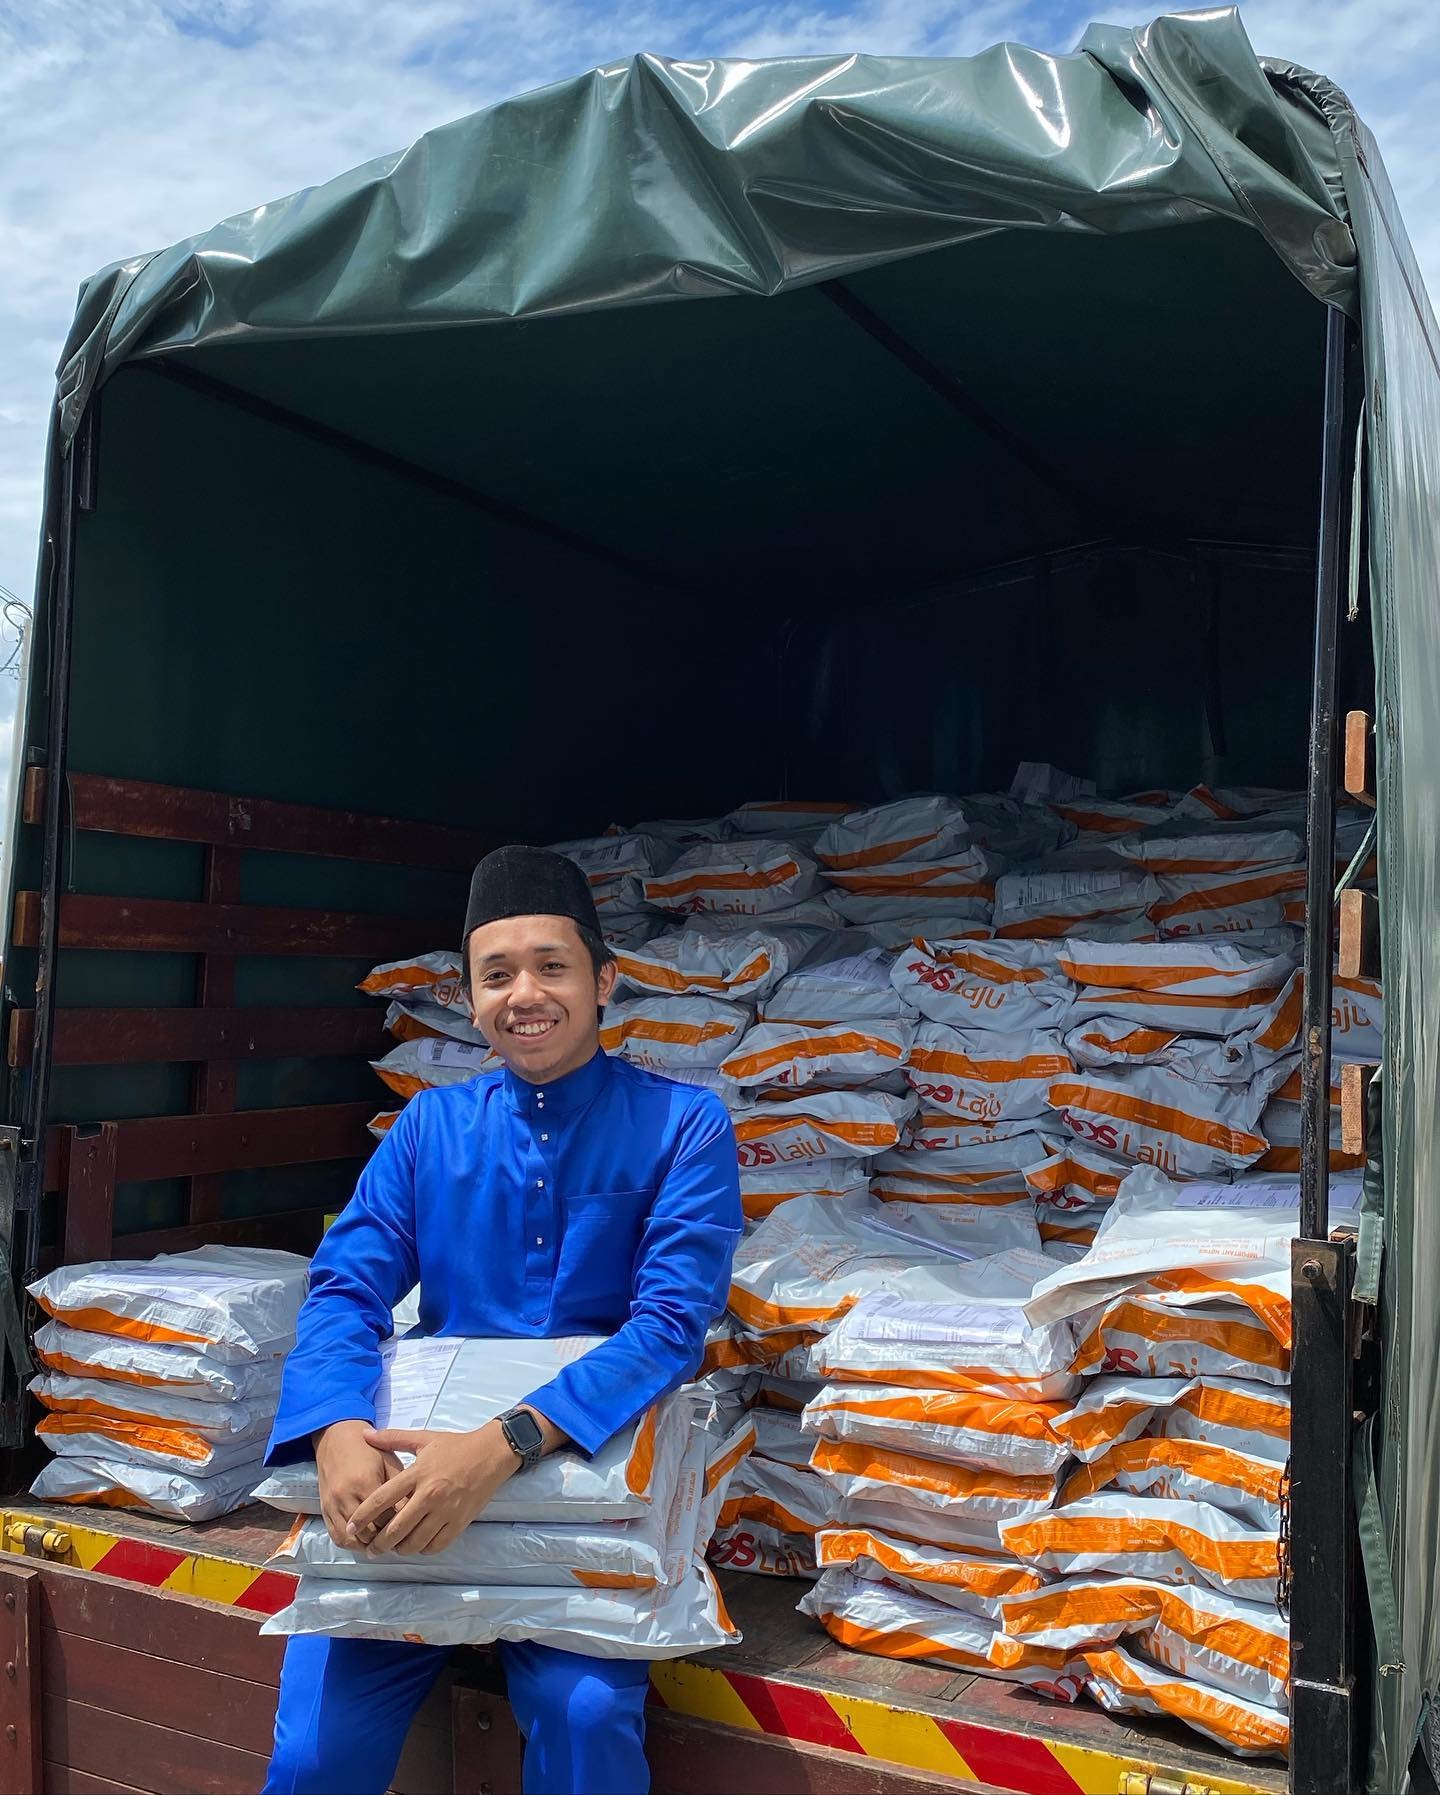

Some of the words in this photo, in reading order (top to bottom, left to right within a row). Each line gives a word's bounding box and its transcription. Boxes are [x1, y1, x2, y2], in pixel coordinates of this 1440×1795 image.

[1331, 998, 1371, 1034] aju
[737, 1142, 777, 1168] OS
[771, 1136, 827, 1162] Laju
[1122, 1133, 1178, 1176] Laju
